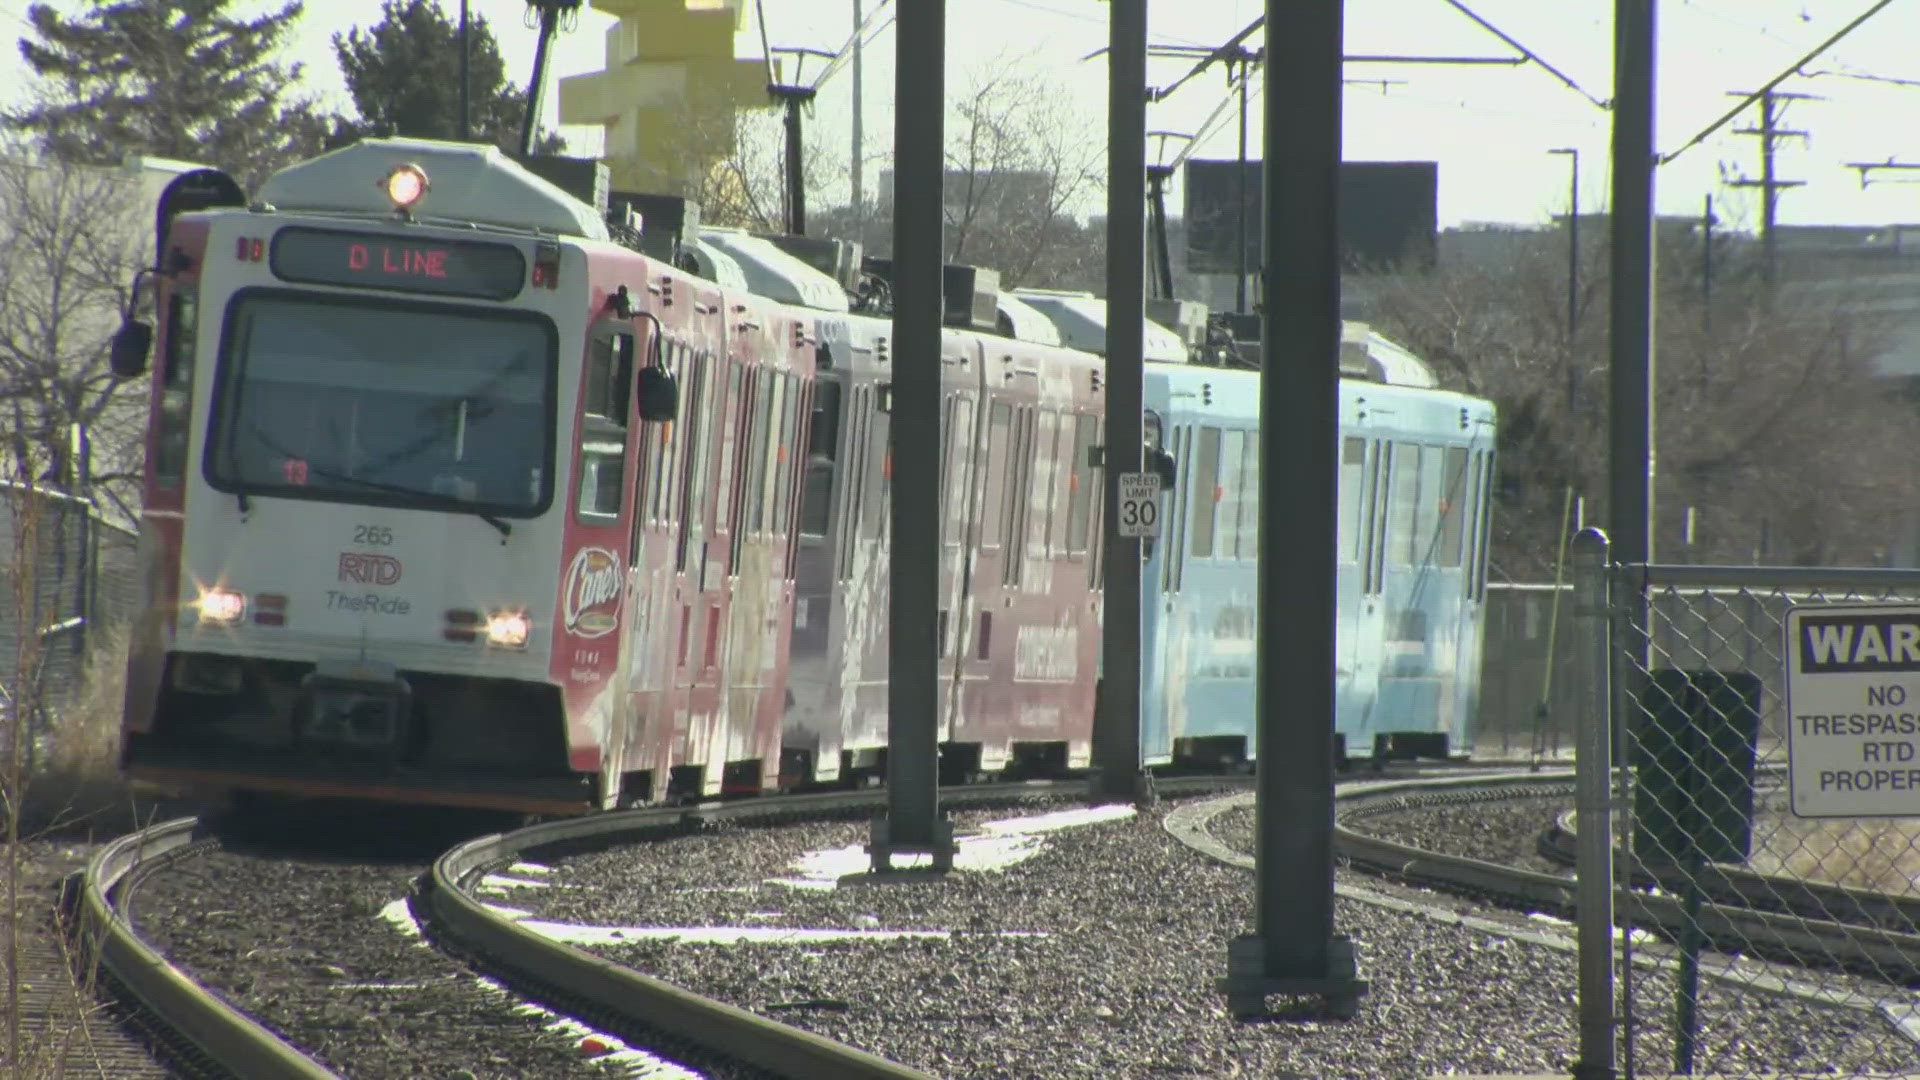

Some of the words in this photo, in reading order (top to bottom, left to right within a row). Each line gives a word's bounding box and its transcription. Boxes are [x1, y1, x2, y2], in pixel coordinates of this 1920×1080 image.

[349, 243, 367, 270] D
[382, 247, 447, 278] LINE
[1121, 475, 1159, 486] SPEED
[1125, 487, 1154, 498] LIMIT
[1123, 500, 1156, 526] 30
[353, 524, 393, 546] 265
[338, 551, 402, 586] RTD
[1867, 684, 1906, 707] NO
[1796, 713, 1920, 736] TRESPAS
[1863, 741, 1915, 763] RTD
